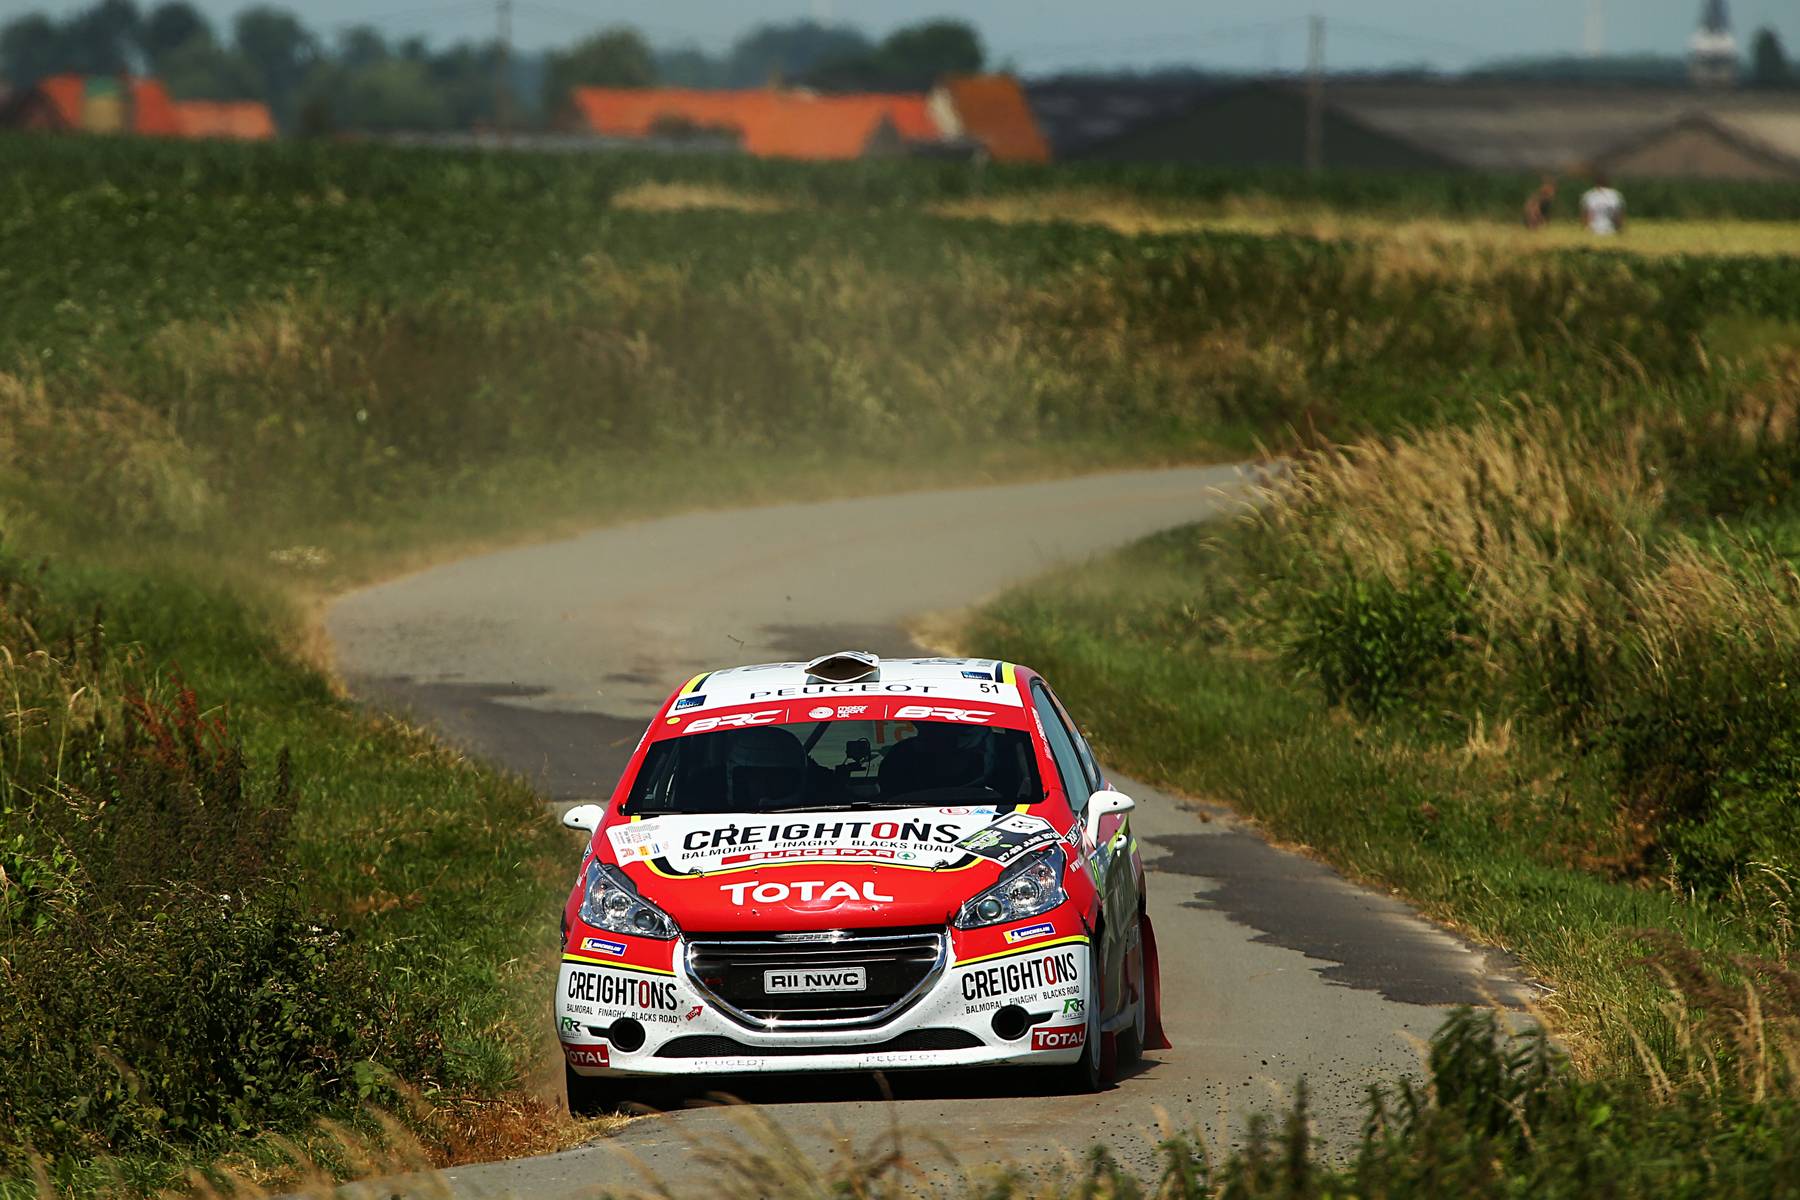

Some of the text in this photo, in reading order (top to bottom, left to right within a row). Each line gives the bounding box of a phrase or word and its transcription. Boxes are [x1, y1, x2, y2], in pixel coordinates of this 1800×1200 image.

[750, 684, 938, 699] PEUGEOT
[980, 684, 999, 694] 51
[682, 709, 783, 734] BRC
[894, 705, 996, 722] BRC
[683, 822, 961, 850] CREIGHTONS
[682, 840, 954, 860] BALMORAL FINAGHY BLACKS ROAD
[720, 881, 894, 905] TOTAL
[806, 973, 859, 987] NWC
[962, 953, 1077, 1000] CREIGHTONS
[568, 971, 677, 1010] CREIGHTONS
[965, 985, 1080, 1014] BALMORAL FINAGHY BLACKS ROAD
[567, 1003, 677, 1024] BALMORAL FINAGHY BLACKS ROAD
[1034, 1029, 1085, 1047] TOTAL
